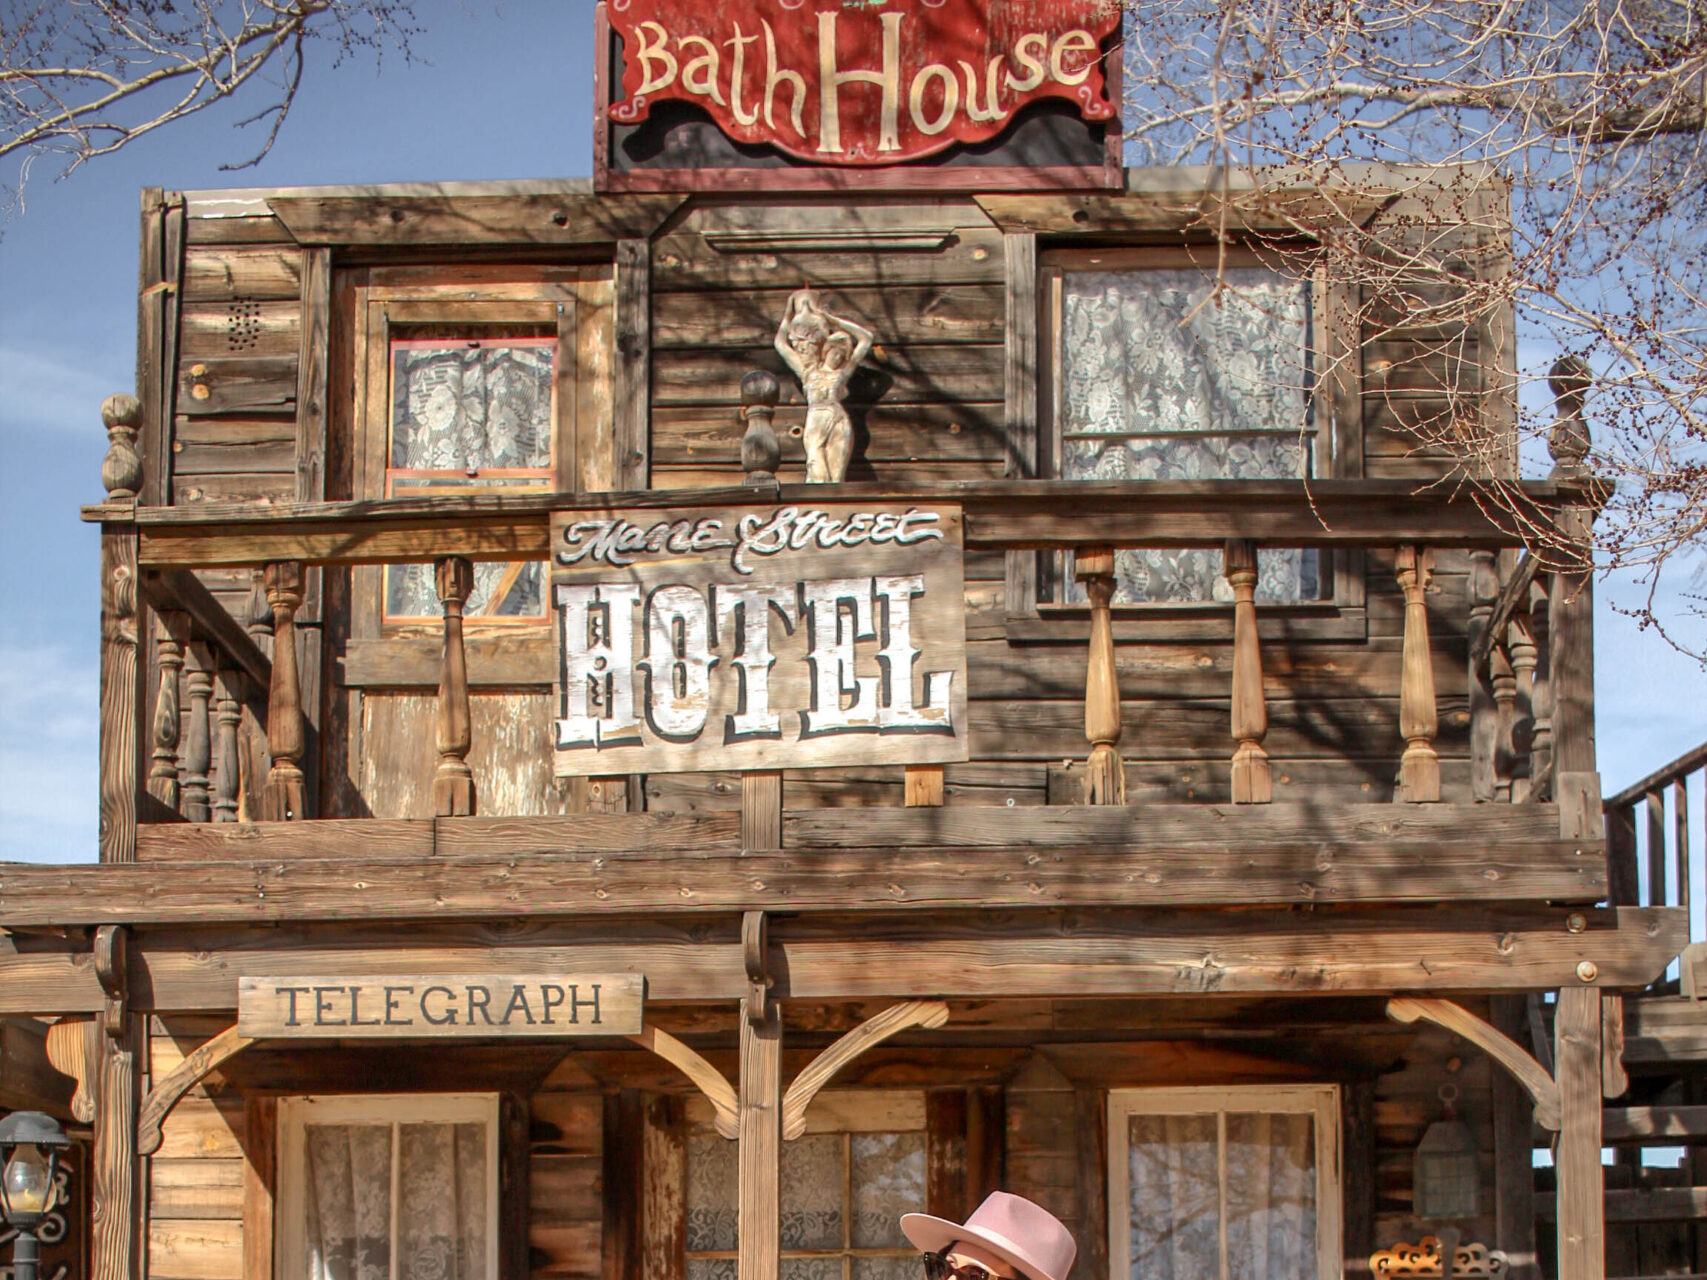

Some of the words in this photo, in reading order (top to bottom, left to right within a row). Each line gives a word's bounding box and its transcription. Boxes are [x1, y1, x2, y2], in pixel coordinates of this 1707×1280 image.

[557, 515, 731, 566] Mane
[731, 507, 944, 573] Street
[553, 573, 955, 750] HOTEL
[275, 984, 602, 1027] TELEGRAPH
